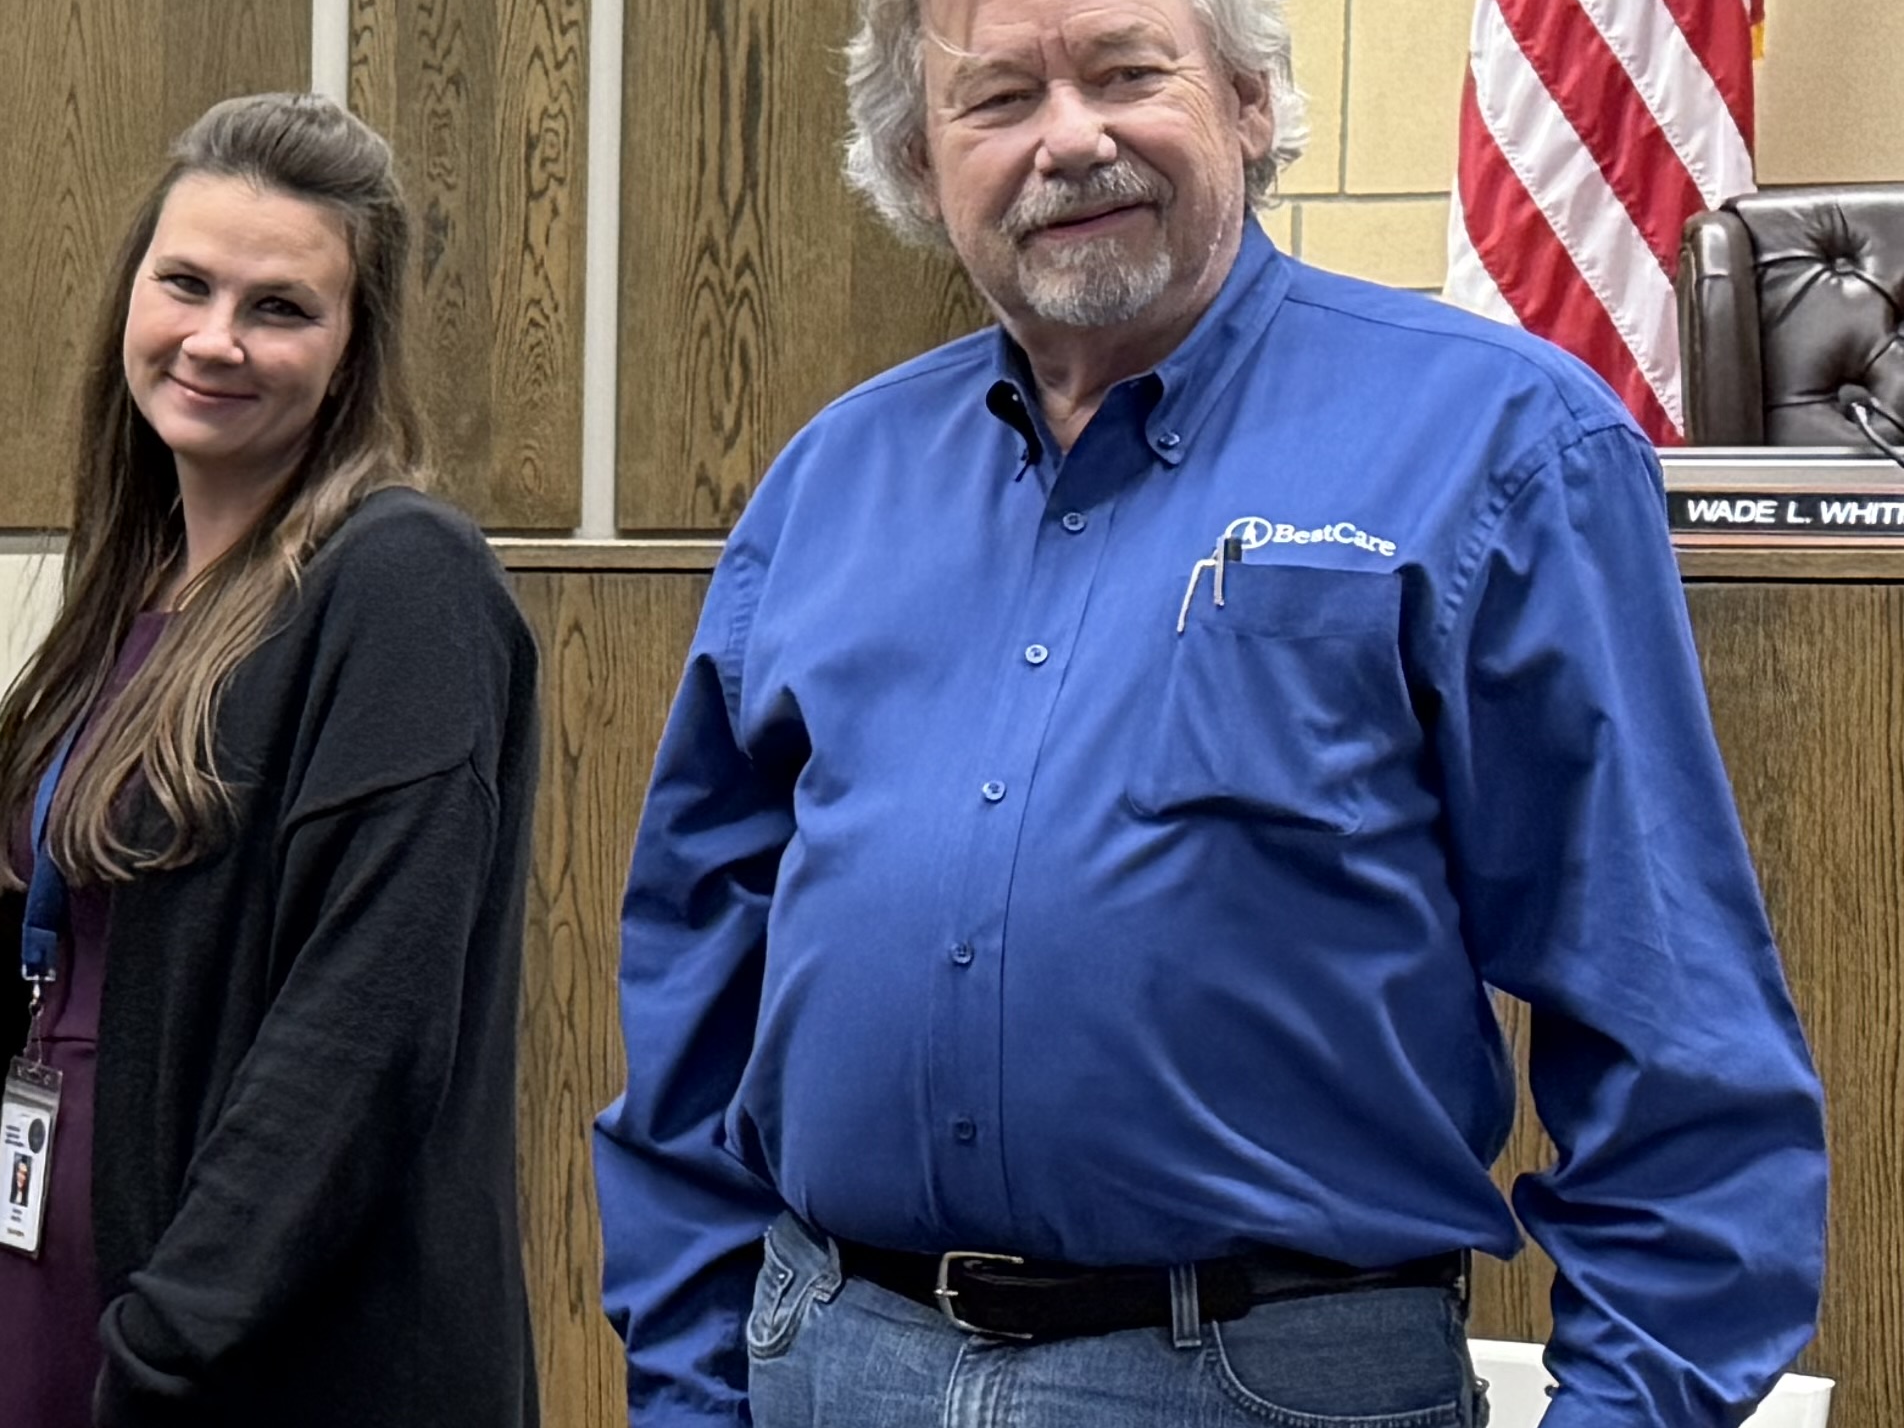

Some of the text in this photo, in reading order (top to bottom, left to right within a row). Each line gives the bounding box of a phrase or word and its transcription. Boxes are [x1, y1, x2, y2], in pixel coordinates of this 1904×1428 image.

[1687, 499, 1778, 523] WADE
[1787, 500, 1811, 525] L.
[1272, 521, 1397, 557] BestCare
